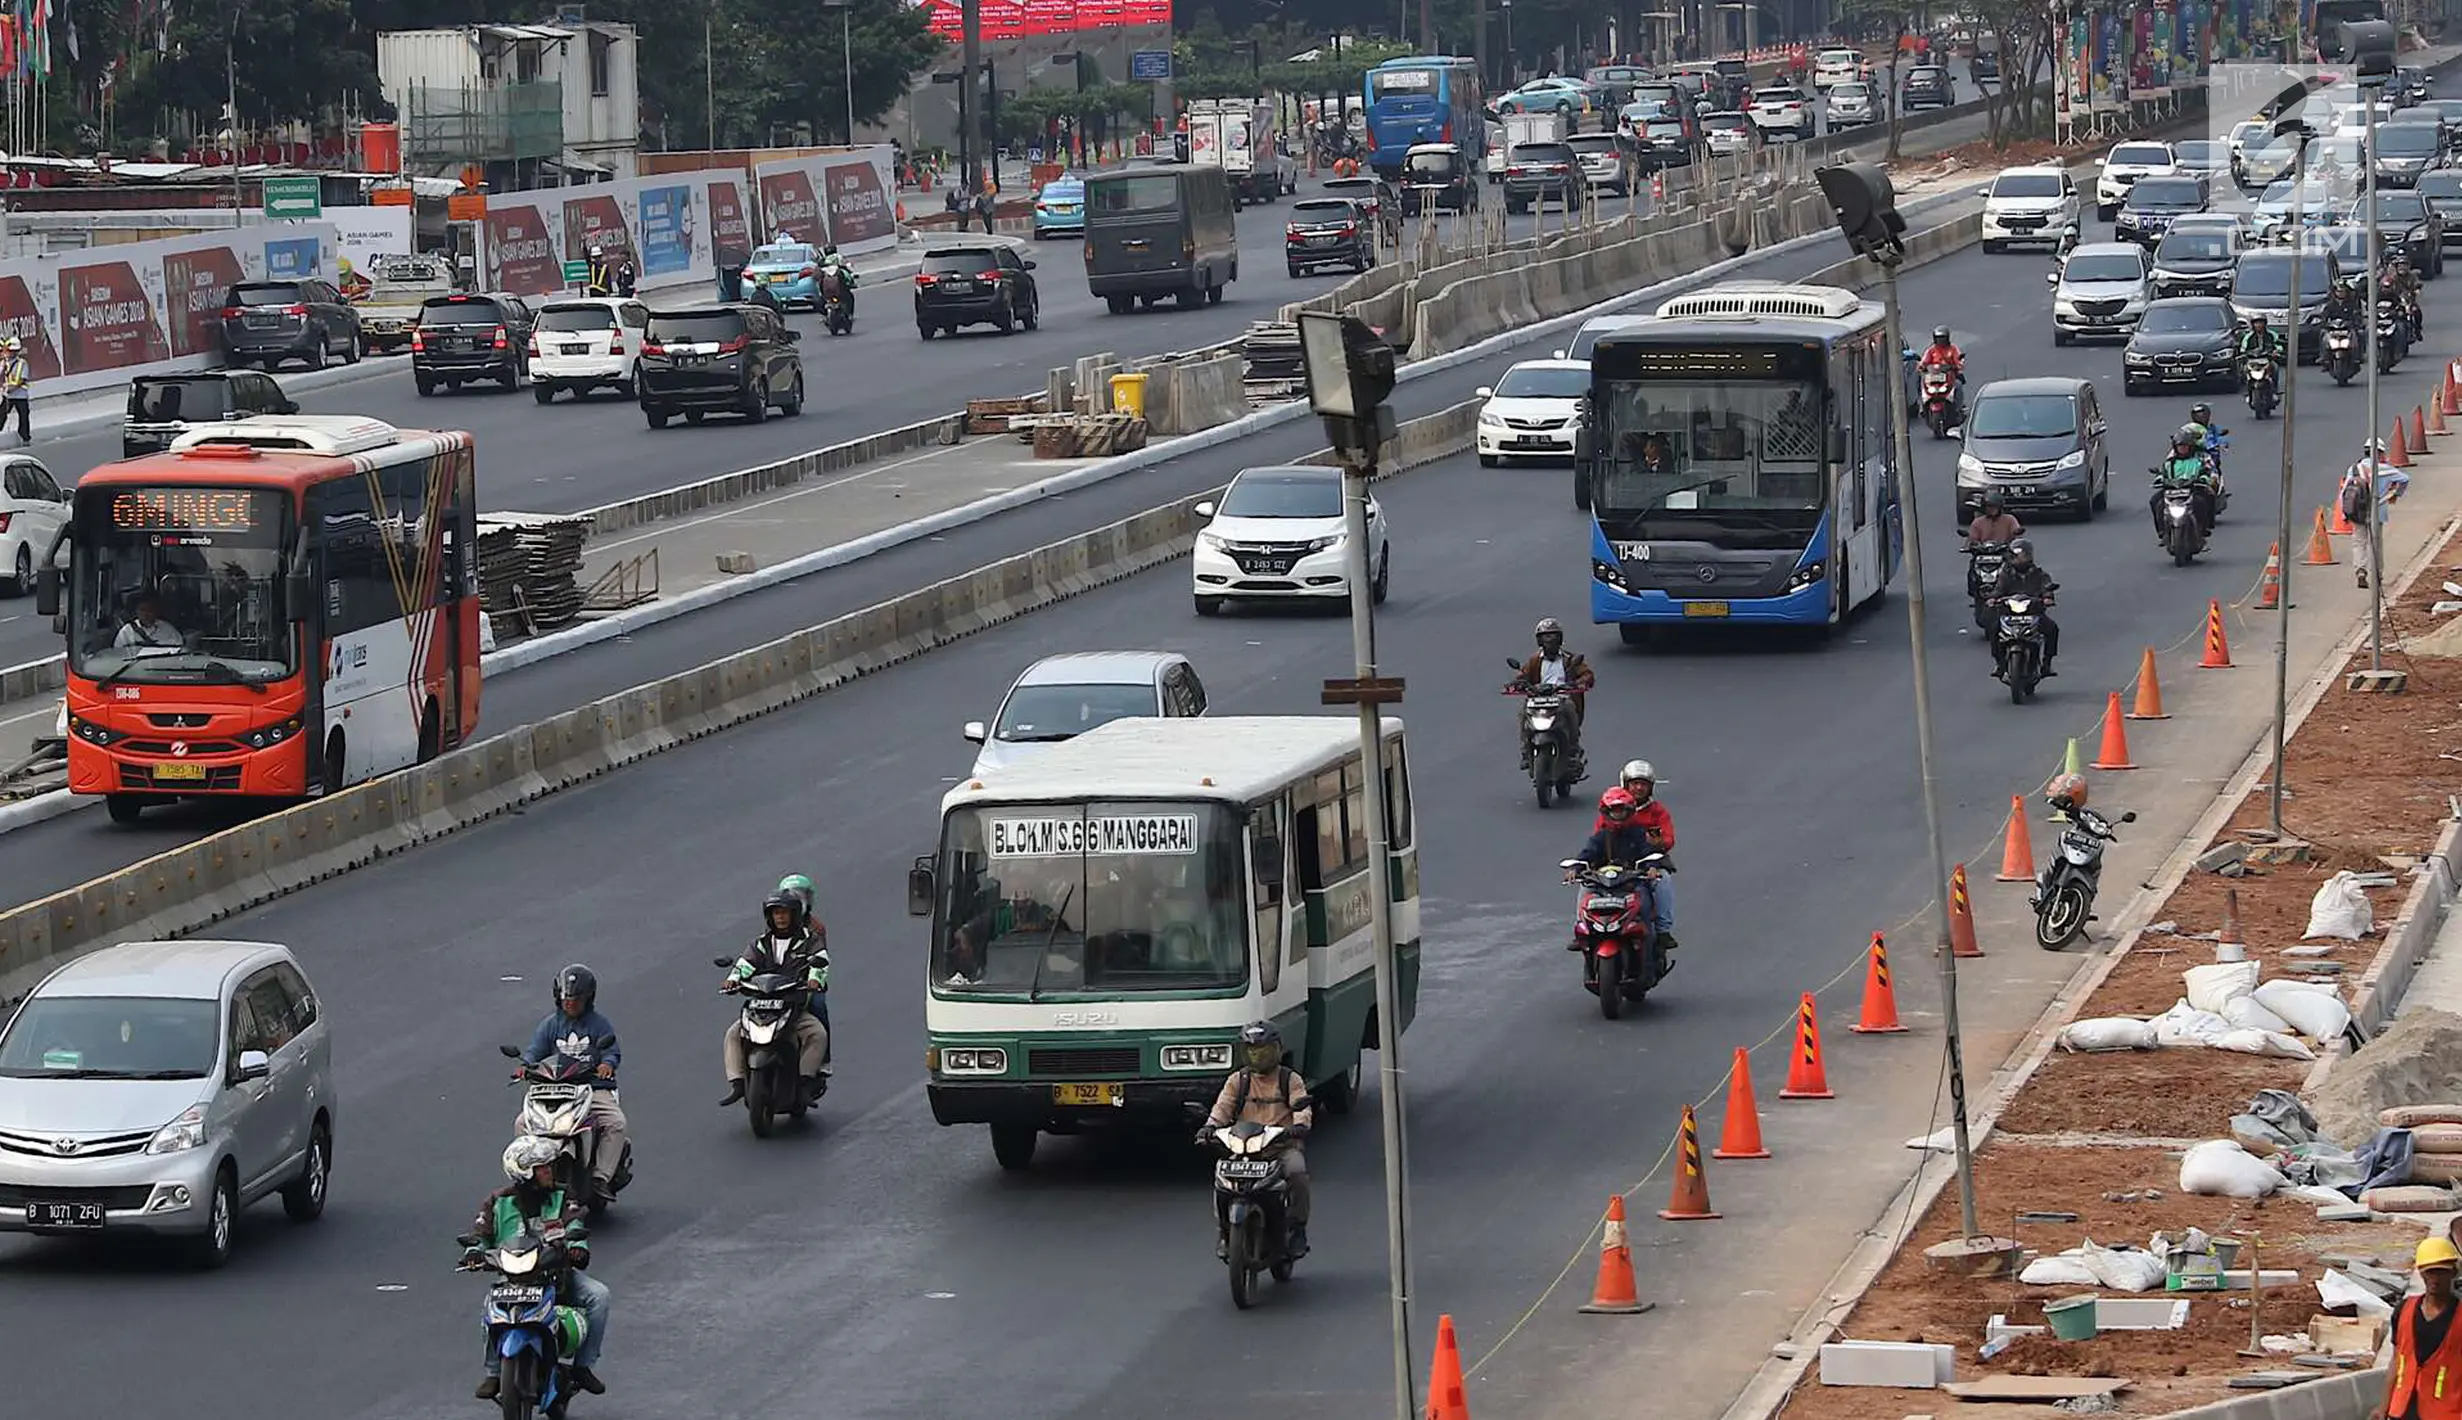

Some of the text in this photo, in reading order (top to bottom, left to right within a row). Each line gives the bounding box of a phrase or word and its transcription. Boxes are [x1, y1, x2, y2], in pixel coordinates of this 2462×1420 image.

[188, 289, 208, 312] ASIAN
[83, 300, 145, 329] ASIAN GAMES 2018
[20, 314, 36, 339] 2018
[1618, 544, 1651, 560] TJ-400
[994, 822, 1053, 854] BLOK.M
[1103, 817, 1192, 851] MANGGARAI
[1053, 1011, 1119, 1027] ISUZU
[1073, 1084, 1098, 1098] 7522
[29, 1204, 100, 1219] B 1071 ZFU
